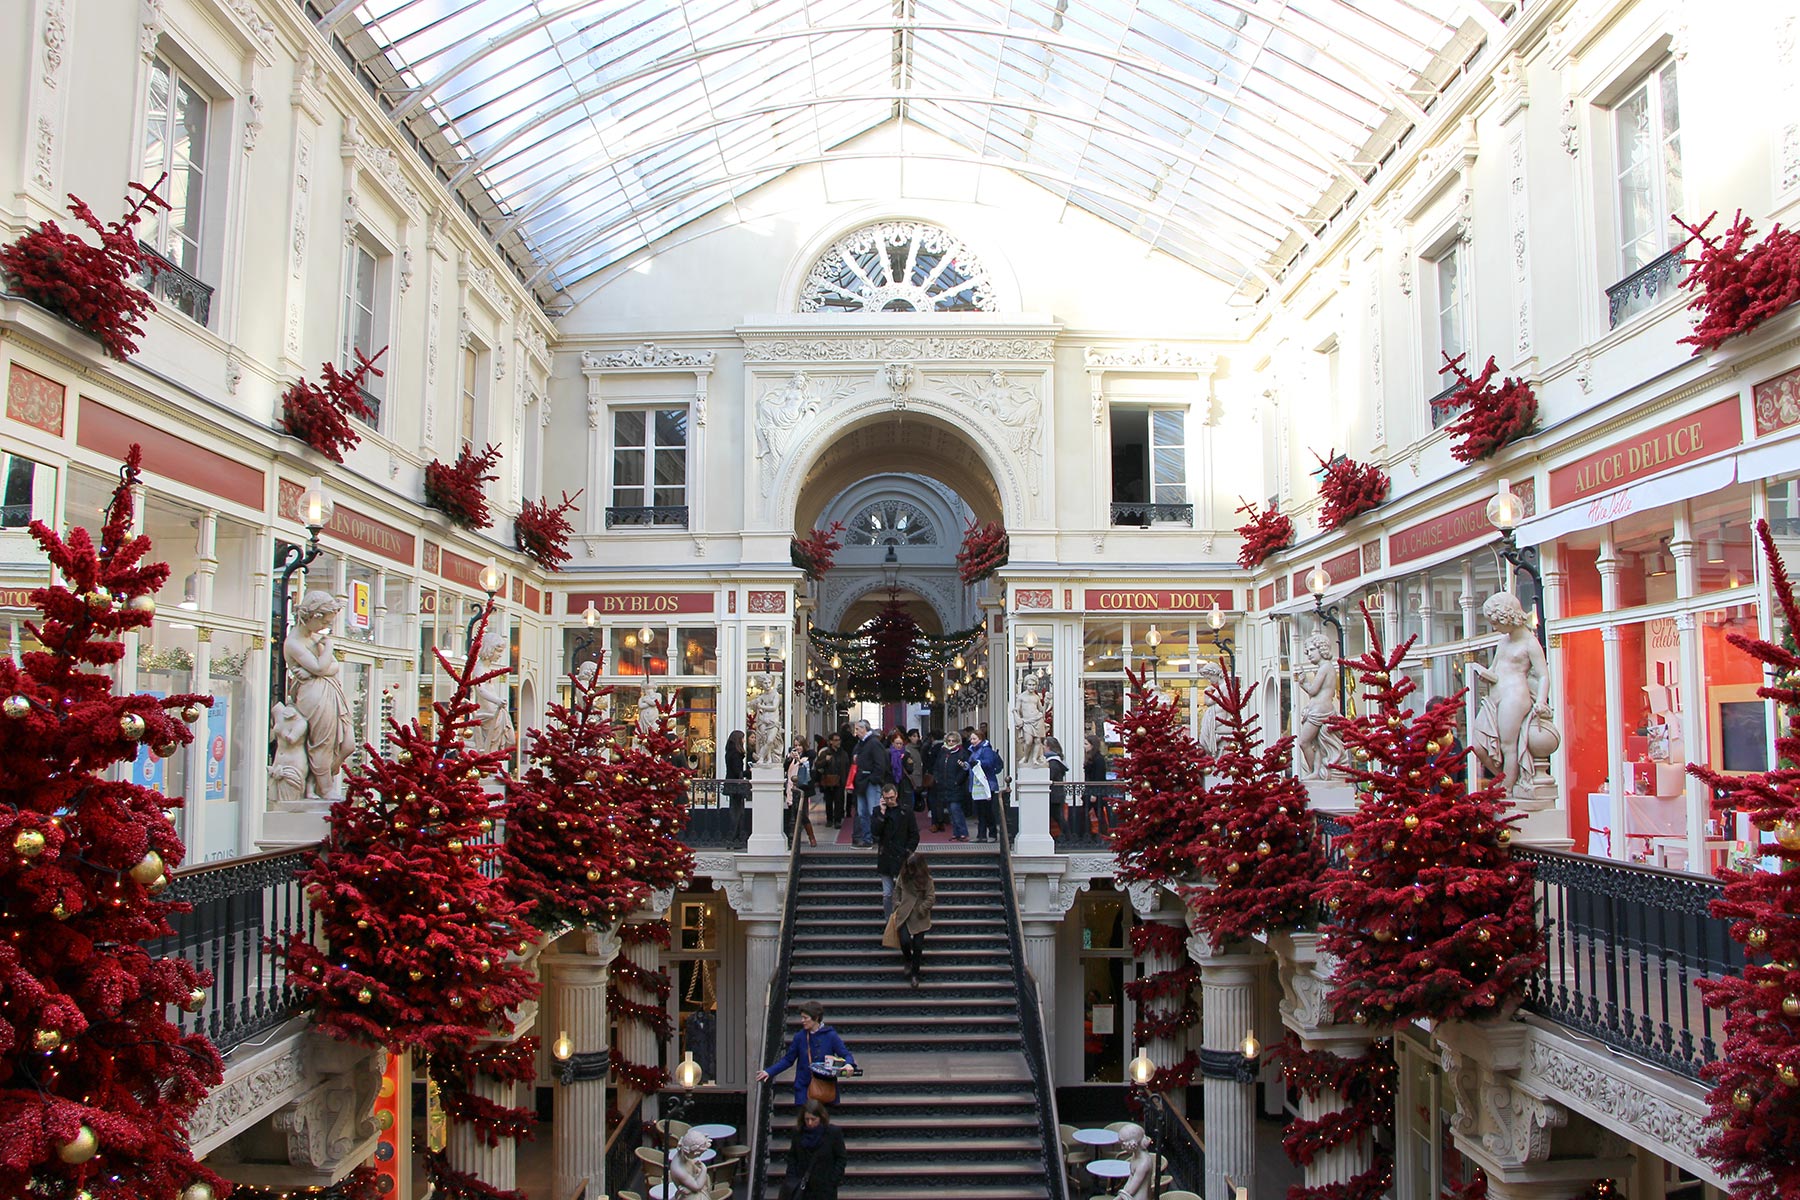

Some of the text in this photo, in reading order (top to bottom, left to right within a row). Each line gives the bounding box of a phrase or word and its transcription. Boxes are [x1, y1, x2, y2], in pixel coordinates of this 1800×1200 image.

[1575, 422, 1704, 494] ALICE DELICE
[329, 511, 401, 554] LES OPTICIENS
[1396, 537, 1408, 558] LA
[1410, 523, 1443, 553] CHAISE
[602, 595, 679, 611] BYBLOS
[1100, 593, 1220, 609] COTON DOUX
